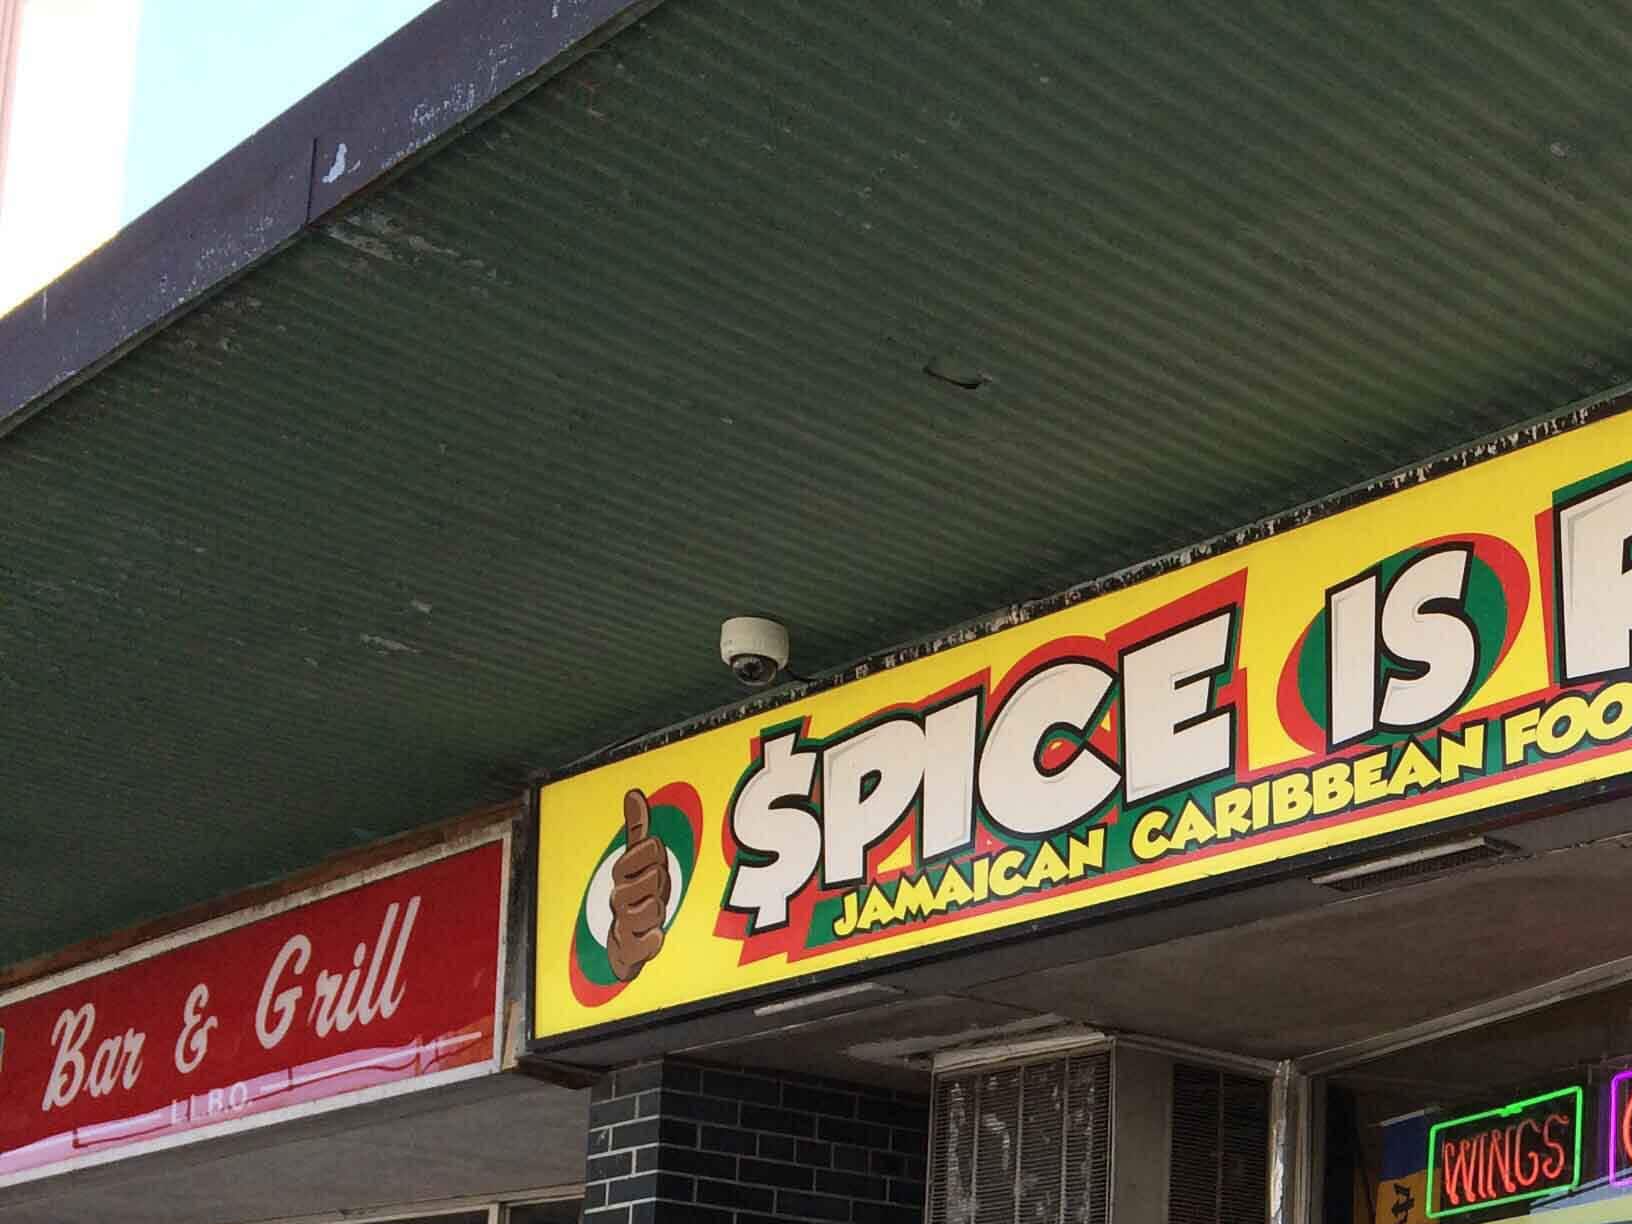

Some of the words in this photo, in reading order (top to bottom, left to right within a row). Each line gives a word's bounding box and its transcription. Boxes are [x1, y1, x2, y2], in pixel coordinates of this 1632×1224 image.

[1328, 545, 1480, 748] IS
[835, 828, 1105, 937] JAMAICAN
[1131, 721, 1485, 862] CARIBBEAN
[42, 1003, 146, 1111] Bar
[174, 983, 218, 1073] &
[255, 895, 421, 1049] Grill
[1442, 1114, 1570, 1205] WINGS
